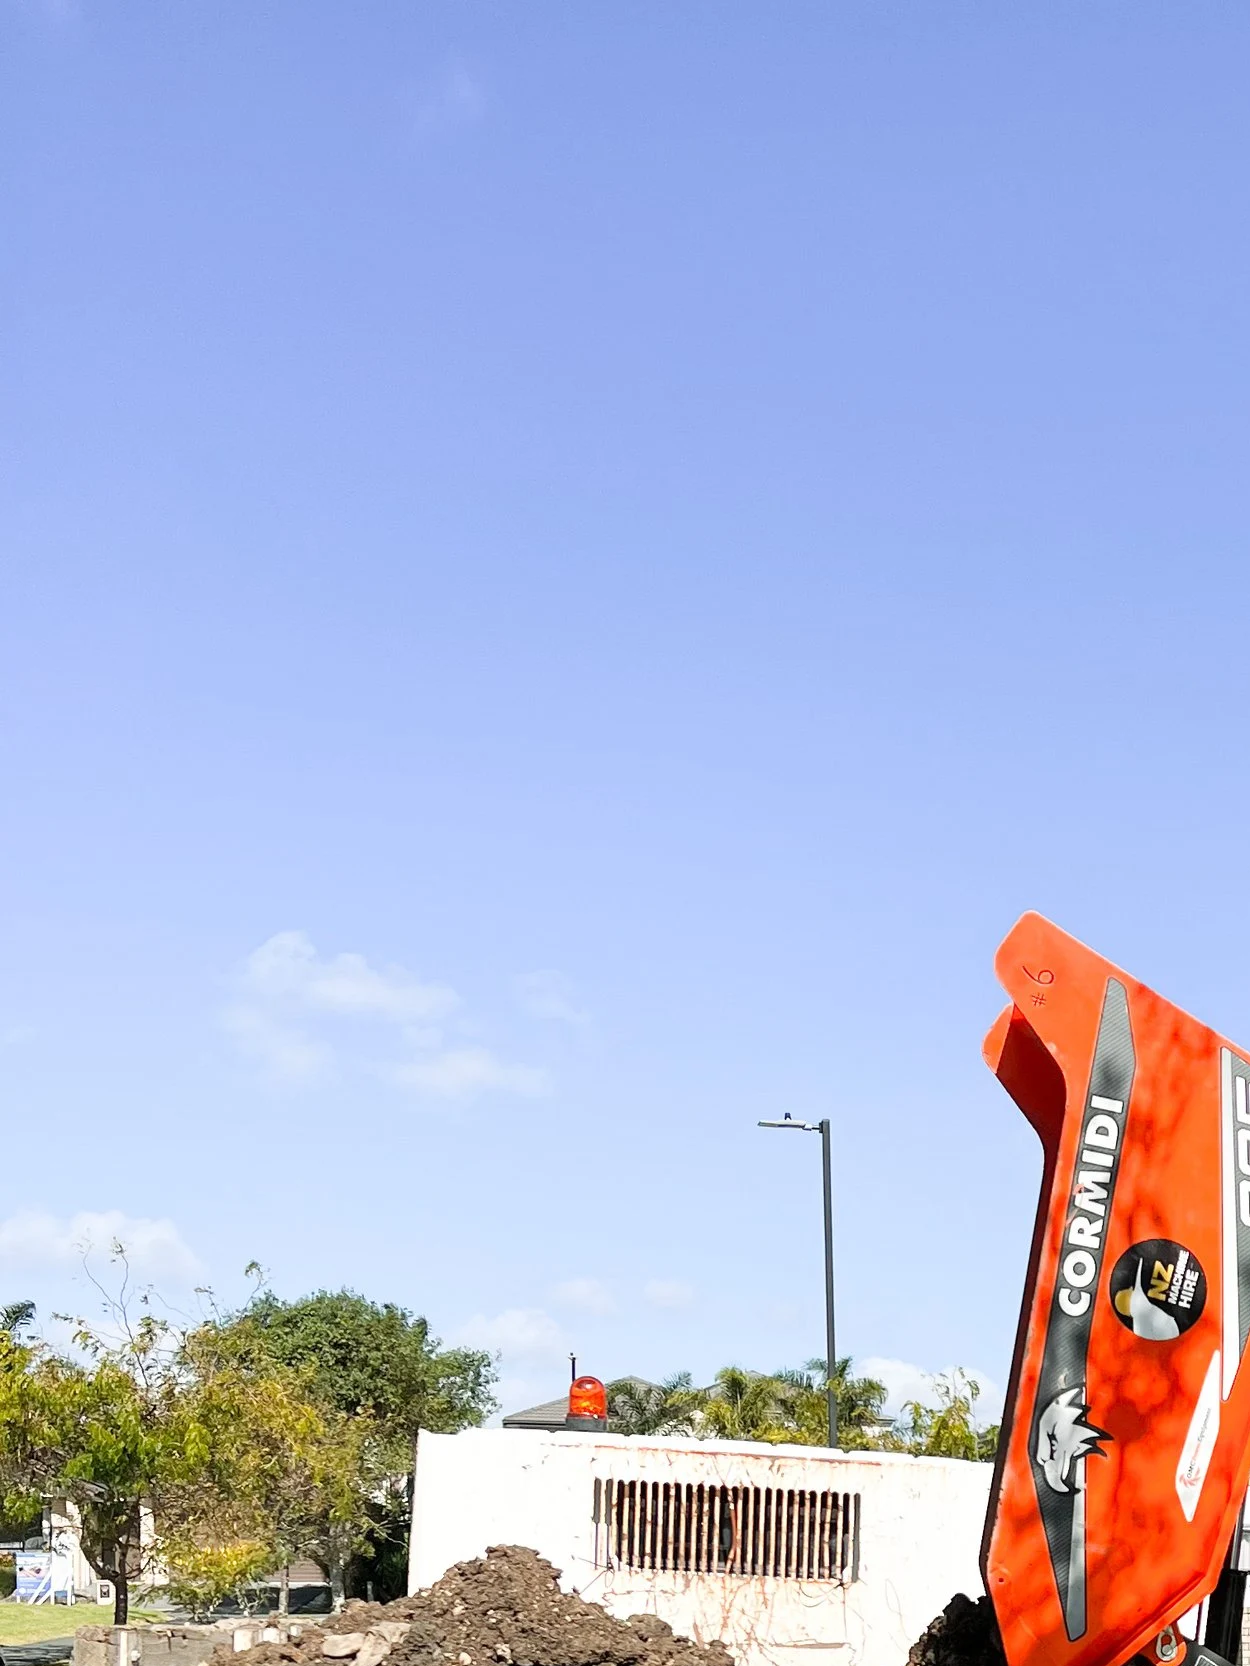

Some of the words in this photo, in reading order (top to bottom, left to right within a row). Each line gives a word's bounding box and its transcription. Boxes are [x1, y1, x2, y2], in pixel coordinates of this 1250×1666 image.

[1058, 1094, 1124, 1317] CORMIDI
[1147, 1260, 1175, 1302] NZ
[1167, 1249, 1190, 1305] MACHINE
[1178, 1268, 1200, 1310] HIRE
